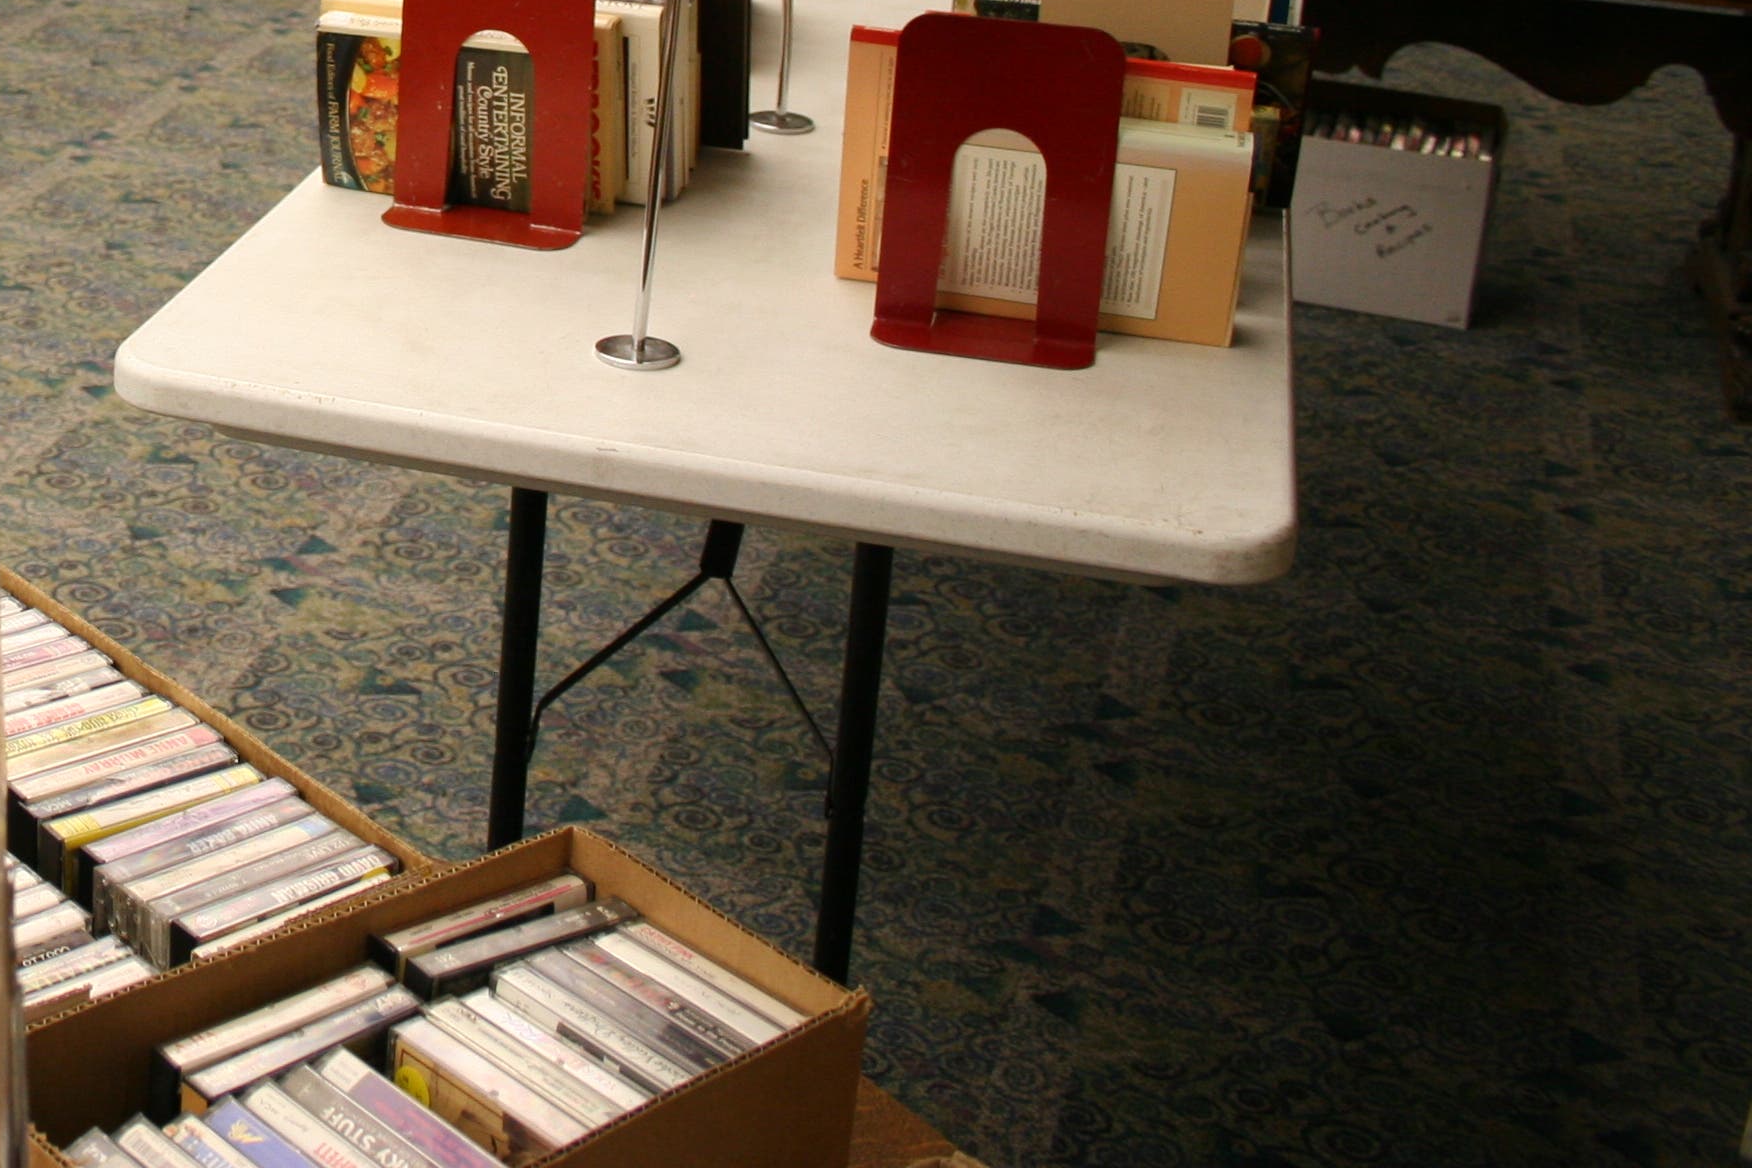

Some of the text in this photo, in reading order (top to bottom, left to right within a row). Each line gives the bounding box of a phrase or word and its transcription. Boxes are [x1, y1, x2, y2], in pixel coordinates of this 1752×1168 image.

[327, 100, 340, 132] FARM
[476, 85, 495, 180] Country Style
[490, 66, 512, 200] ENTERTAINING
[509, 92, 528, 183] INFORMAL
[328, 133, 343, 182] JOURNAL
[855, 178, 869, 271] A Heartfelt Difference
[82, 731, 188, 779] ANNE MURRAY
[185, 809, 278, 855] ANITA BAKER
[337, 851, 381, 879] DAVID
[320, 1105, 374, 1153] STUFF
